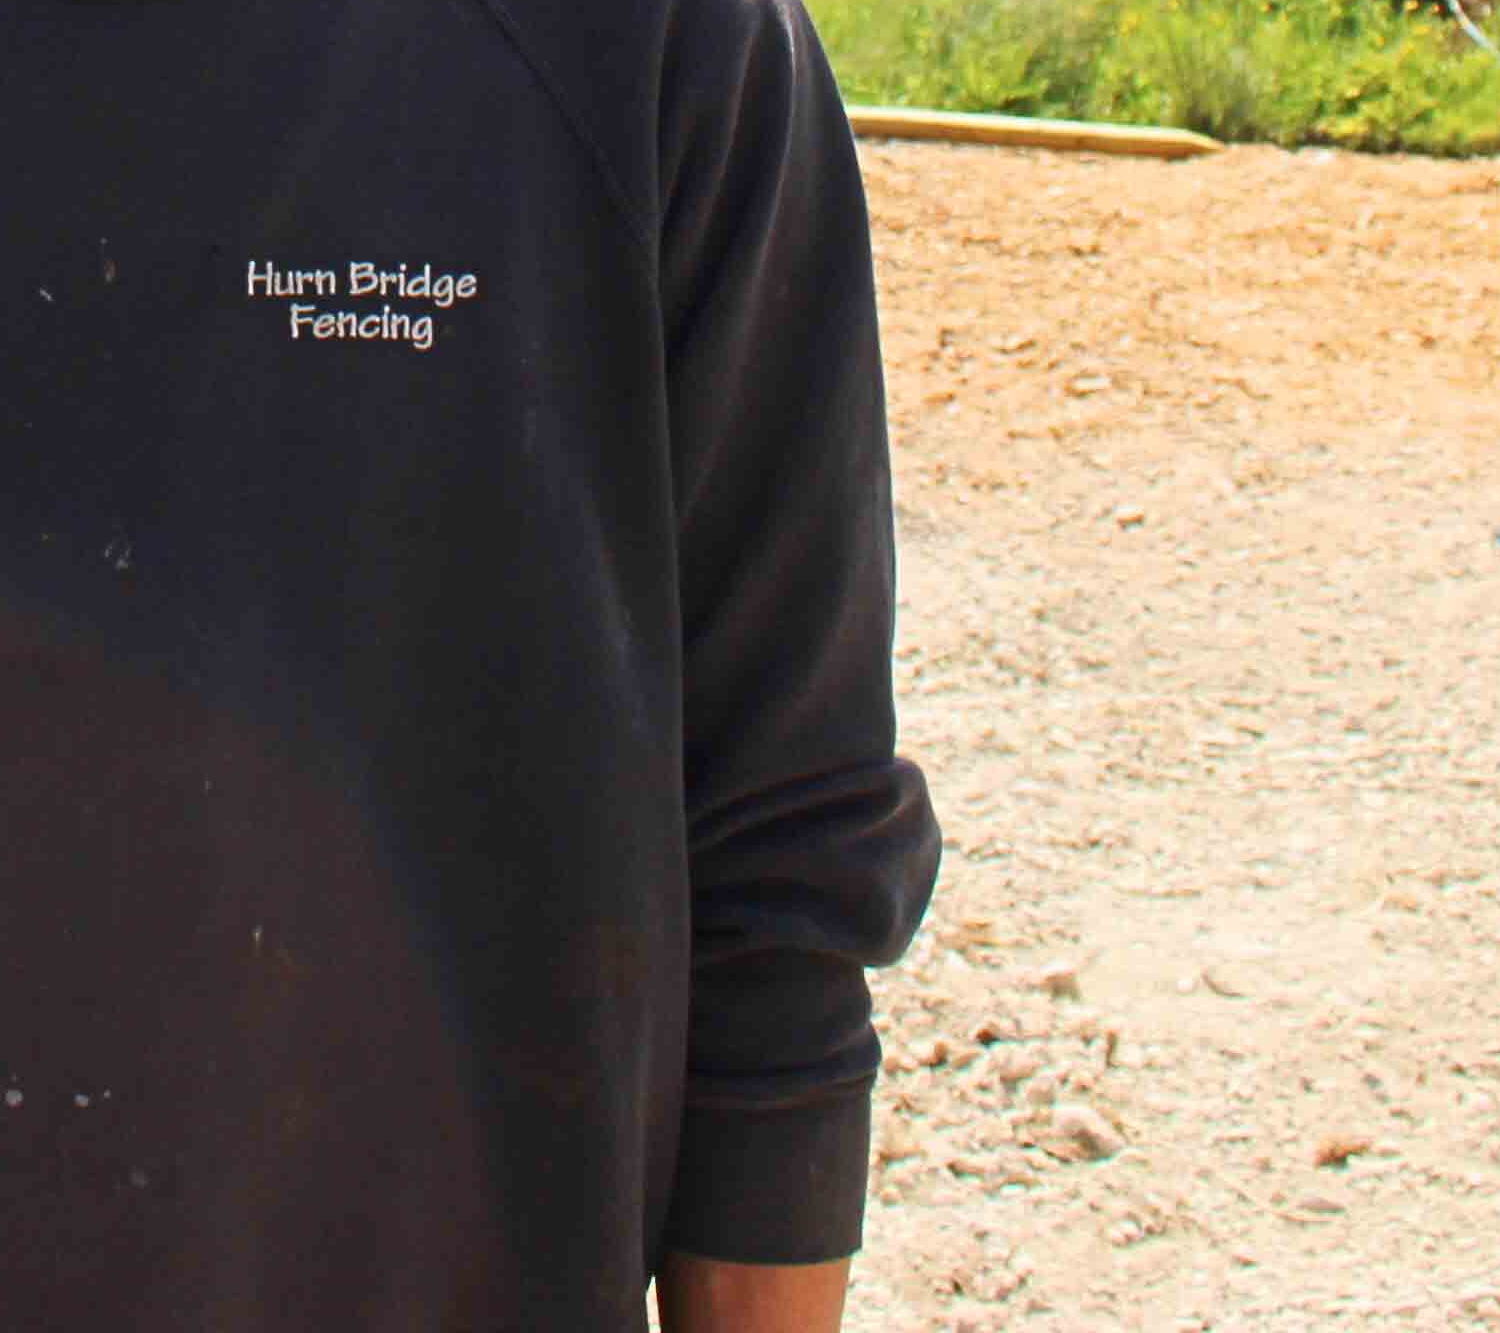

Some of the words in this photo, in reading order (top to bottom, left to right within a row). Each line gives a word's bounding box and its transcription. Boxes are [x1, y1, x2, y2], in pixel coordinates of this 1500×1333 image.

[248, 260, 337, 296] Hurn
[349, 260, 478, 307] Bridge
[290, 303, 433, 350] Fencing
